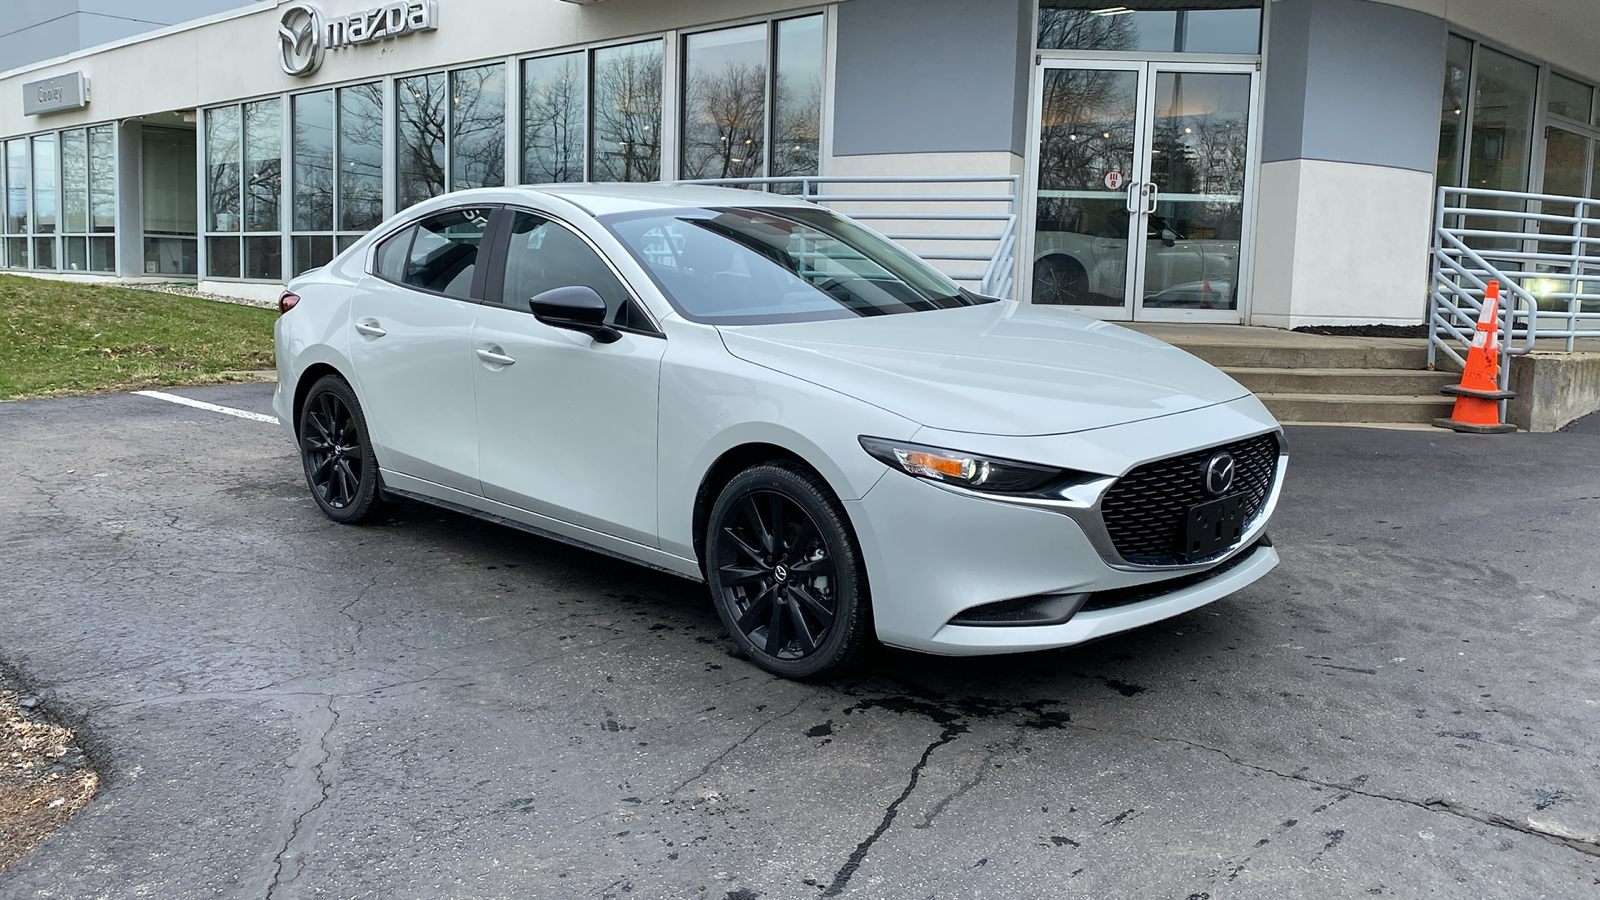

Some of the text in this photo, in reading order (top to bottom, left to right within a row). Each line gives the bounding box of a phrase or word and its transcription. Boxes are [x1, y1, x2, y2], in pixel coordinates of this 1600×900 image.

[37, 80, 63, 104] Cooley
[549, 152, 578, 162] MAZDA
[1110, 180, 1116, 188] R
